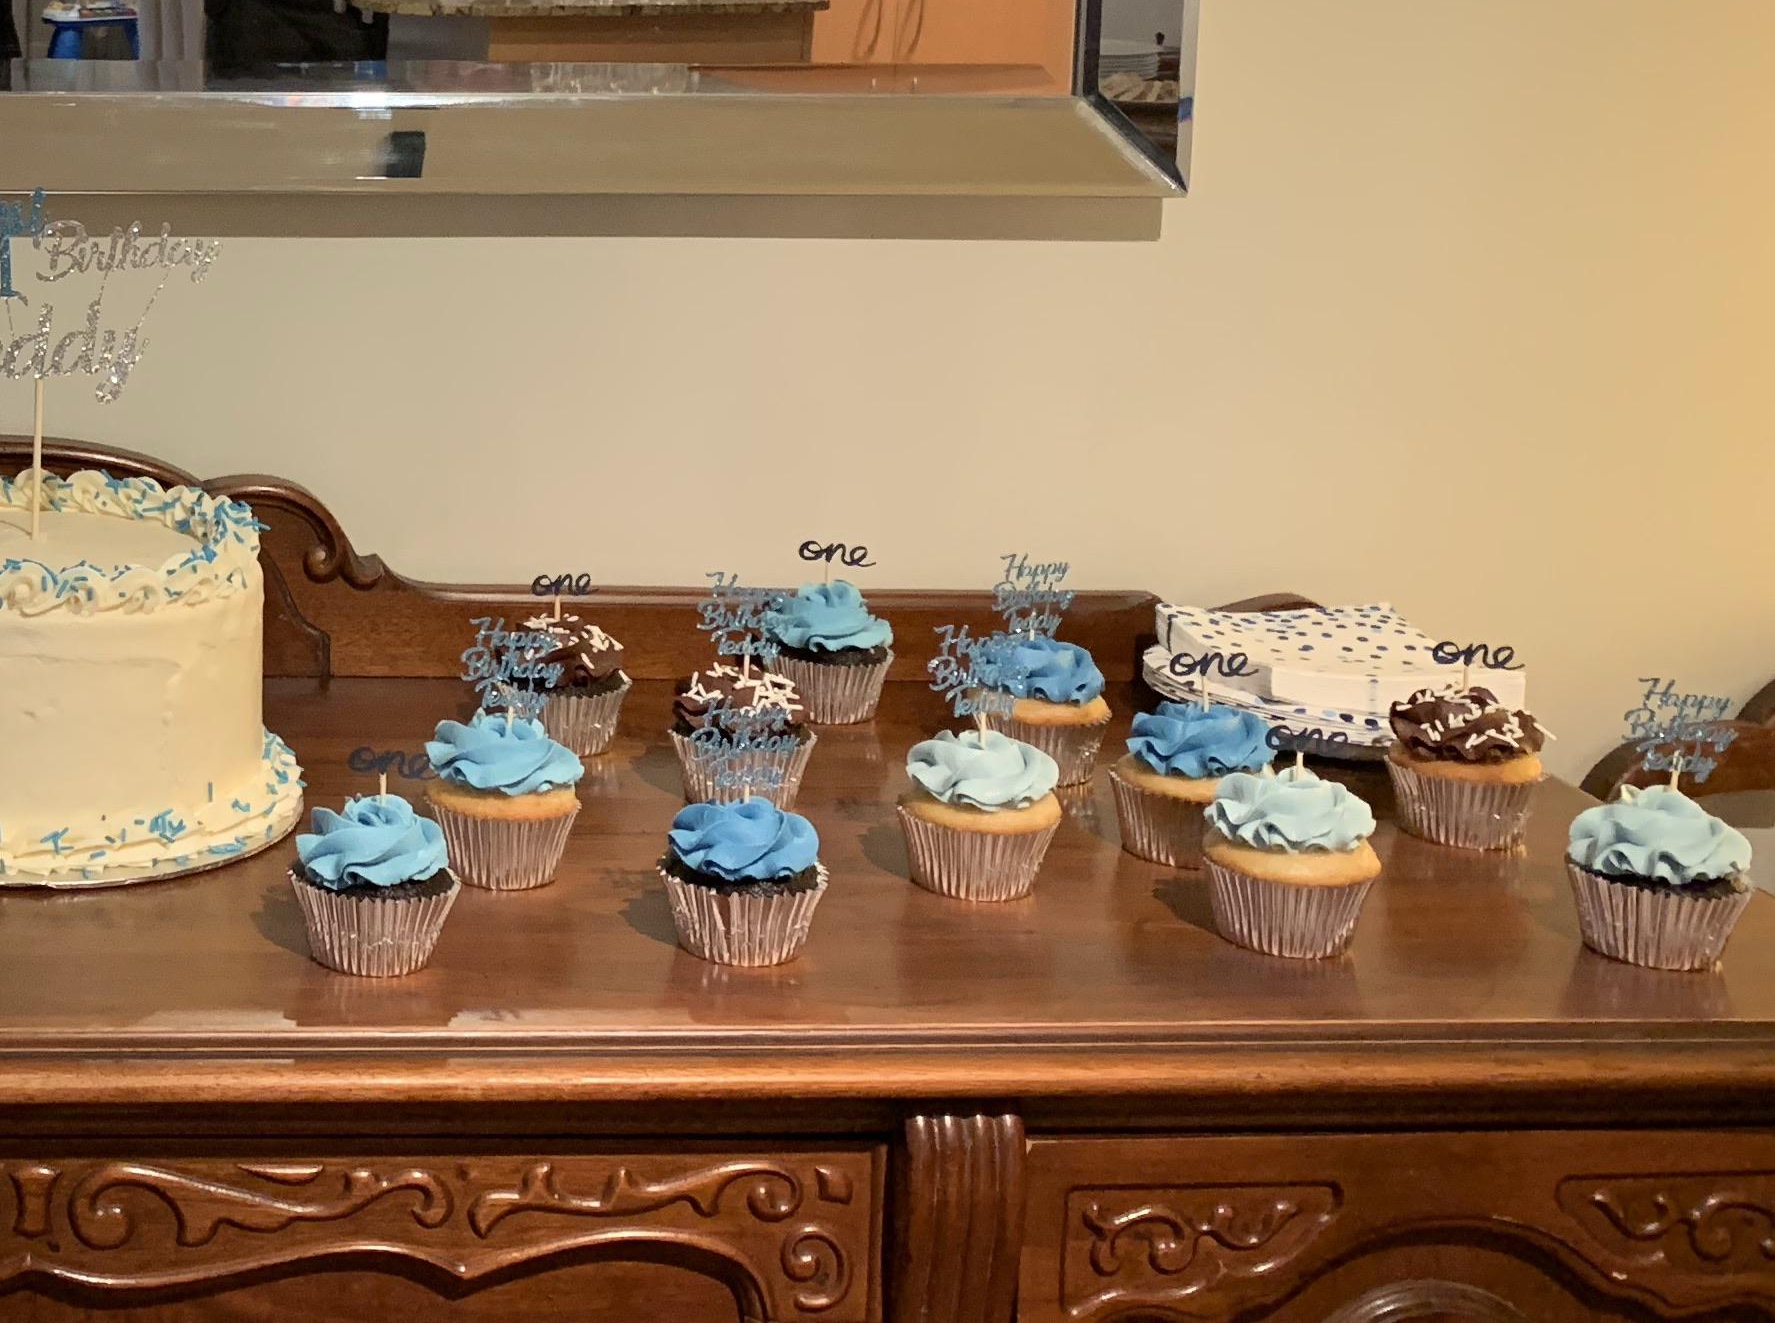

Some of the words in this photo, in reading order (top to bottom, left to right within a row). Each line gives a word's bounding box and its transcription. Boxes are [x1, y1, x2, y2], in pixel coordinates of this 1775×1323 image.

[32, 219, 224, 284] Birthday
[799, 540, 876, 567] one
[1000, 552, 1070, 584] Happy
[531, 573, 600, 596] one
[468, 616, 564, 659] Happy
[1003, 604, 1064, 638] Teddy
[710, 627, 781, 666] Teddy
[1169, 651, 1259, 677] one
[1432, 641, 1525, 670] one
[461, 646, 566, 689] Birthday
[1638, 676, 1731, 719] Happy
[689, 725, 802, 762] Birthday
[1622, 708, 1739, 754] Birthday
[348, 746, 441, 780] one
